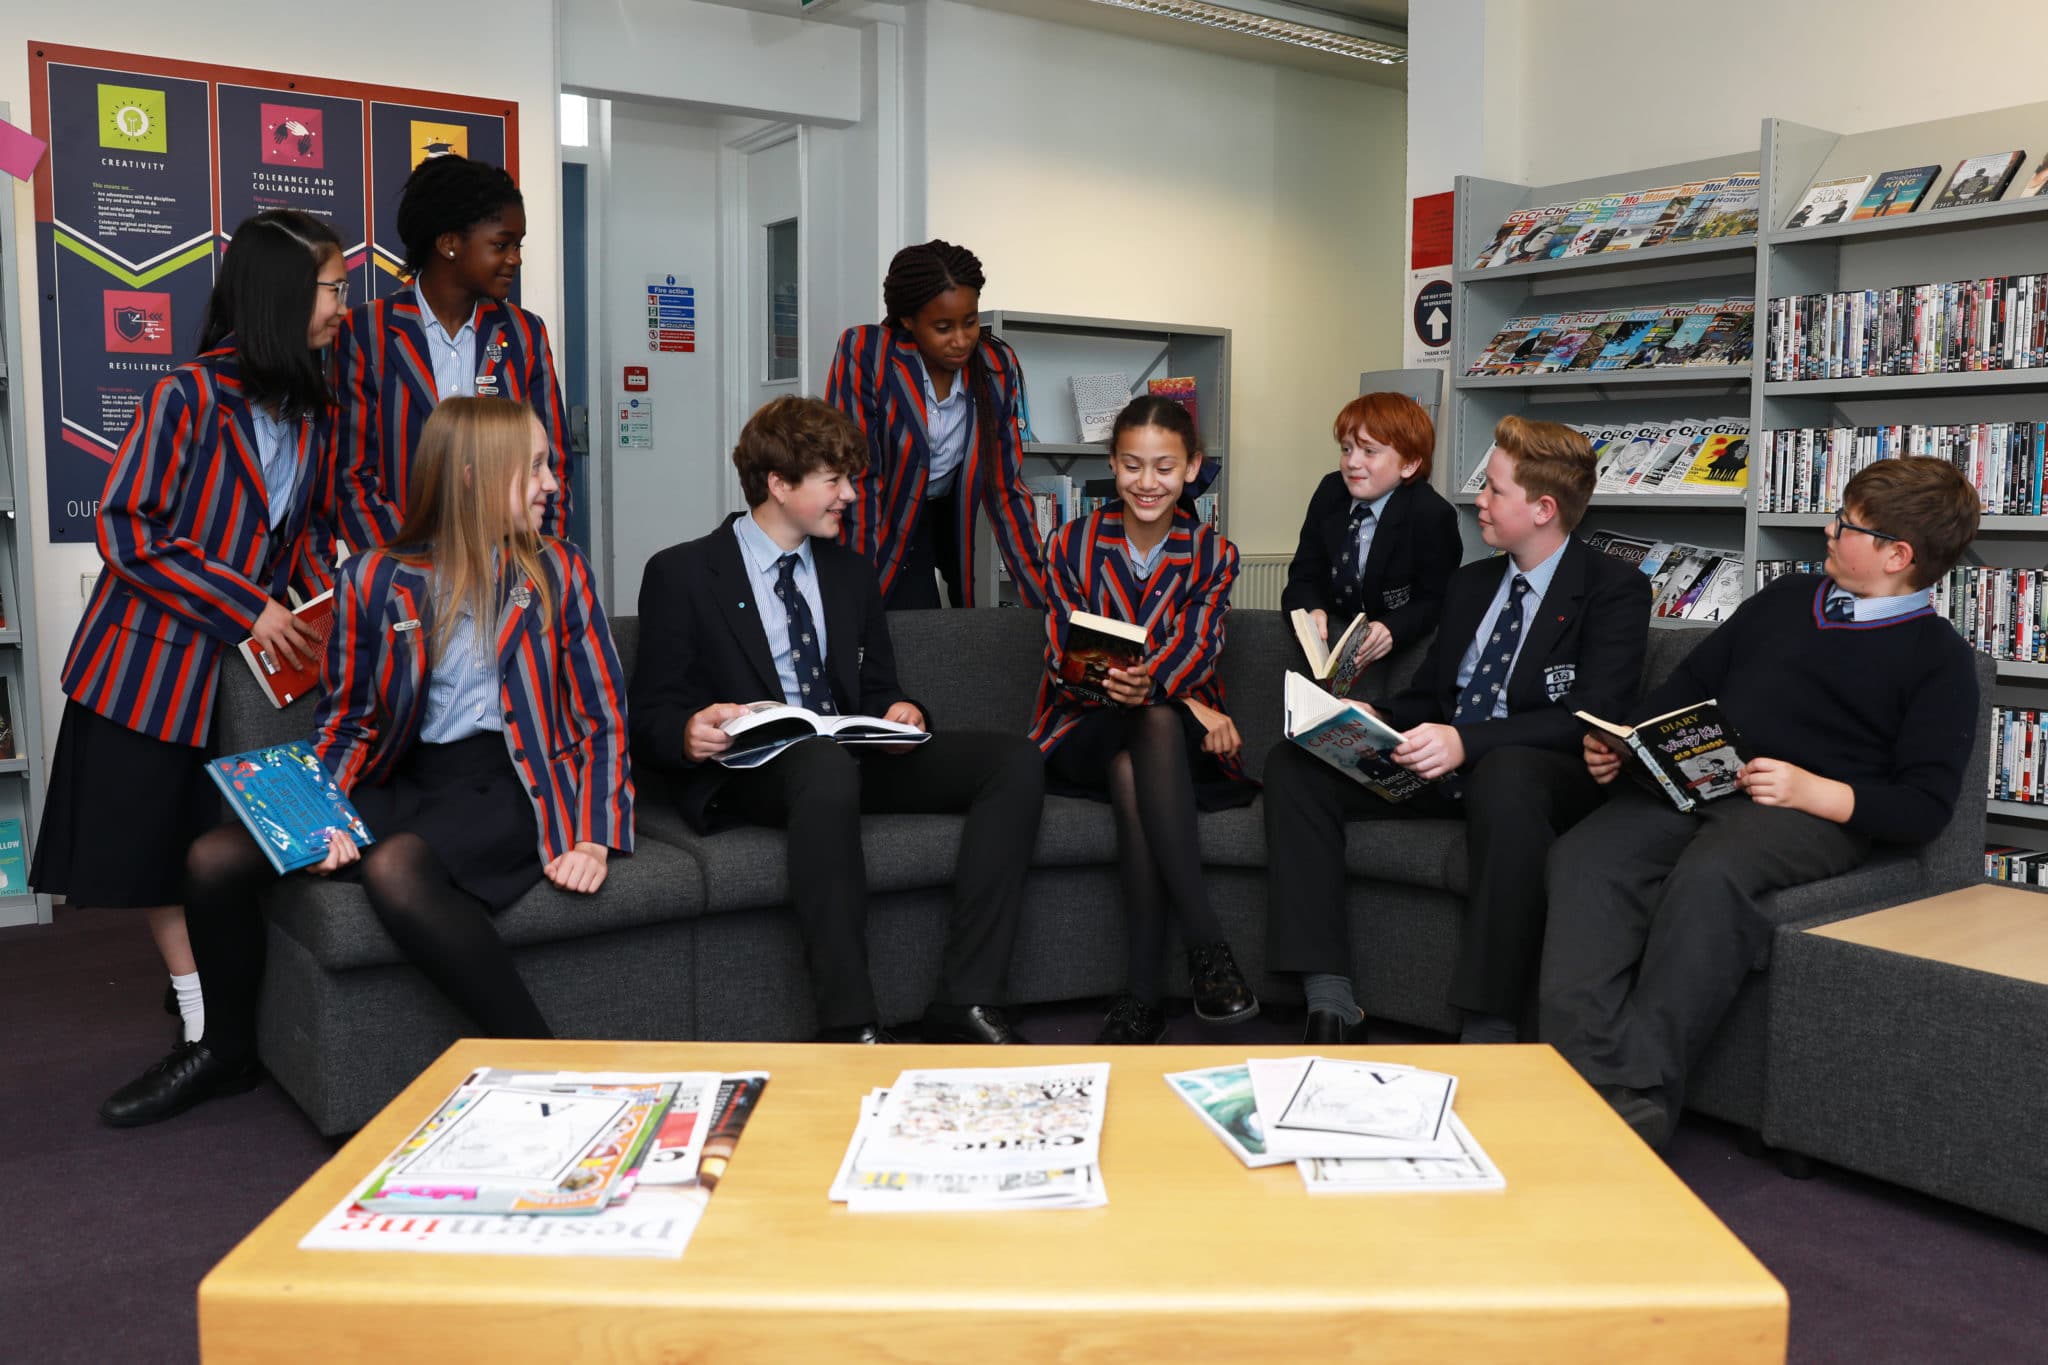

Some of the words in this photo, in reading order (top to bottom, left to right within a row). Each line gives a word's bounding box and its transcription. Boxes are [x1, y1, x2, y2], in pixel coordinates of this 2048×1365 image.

[101, 158, 165, 171] CREATIVITY
[253, 172, 309, 184] TOLERANCE
[315, 178, 334, 186] AND
[1883, 179, 1917, 189] KING
[253, 183, 334, 196] COLLABORATION
[1812, 193, 1846, 204] OLLIE
[109, 362, 171, 371] RESILIENCE
[1659, 713, 1698, 734] DIARY
[1308, 719, 1366, 748] CAPTAIN
[1332, 733, 1365, 750] TOM
[1657, 733, 1700, 753] Wimpy
[1697, 723, 1723, 740] Kid
[1673, 750, 1691, 761] OLD
[1691, 738, 1727, 754] SCHOOL
[1389, 781, 1422, 797] Good
[331, 1211, 680, 1245] Designing
